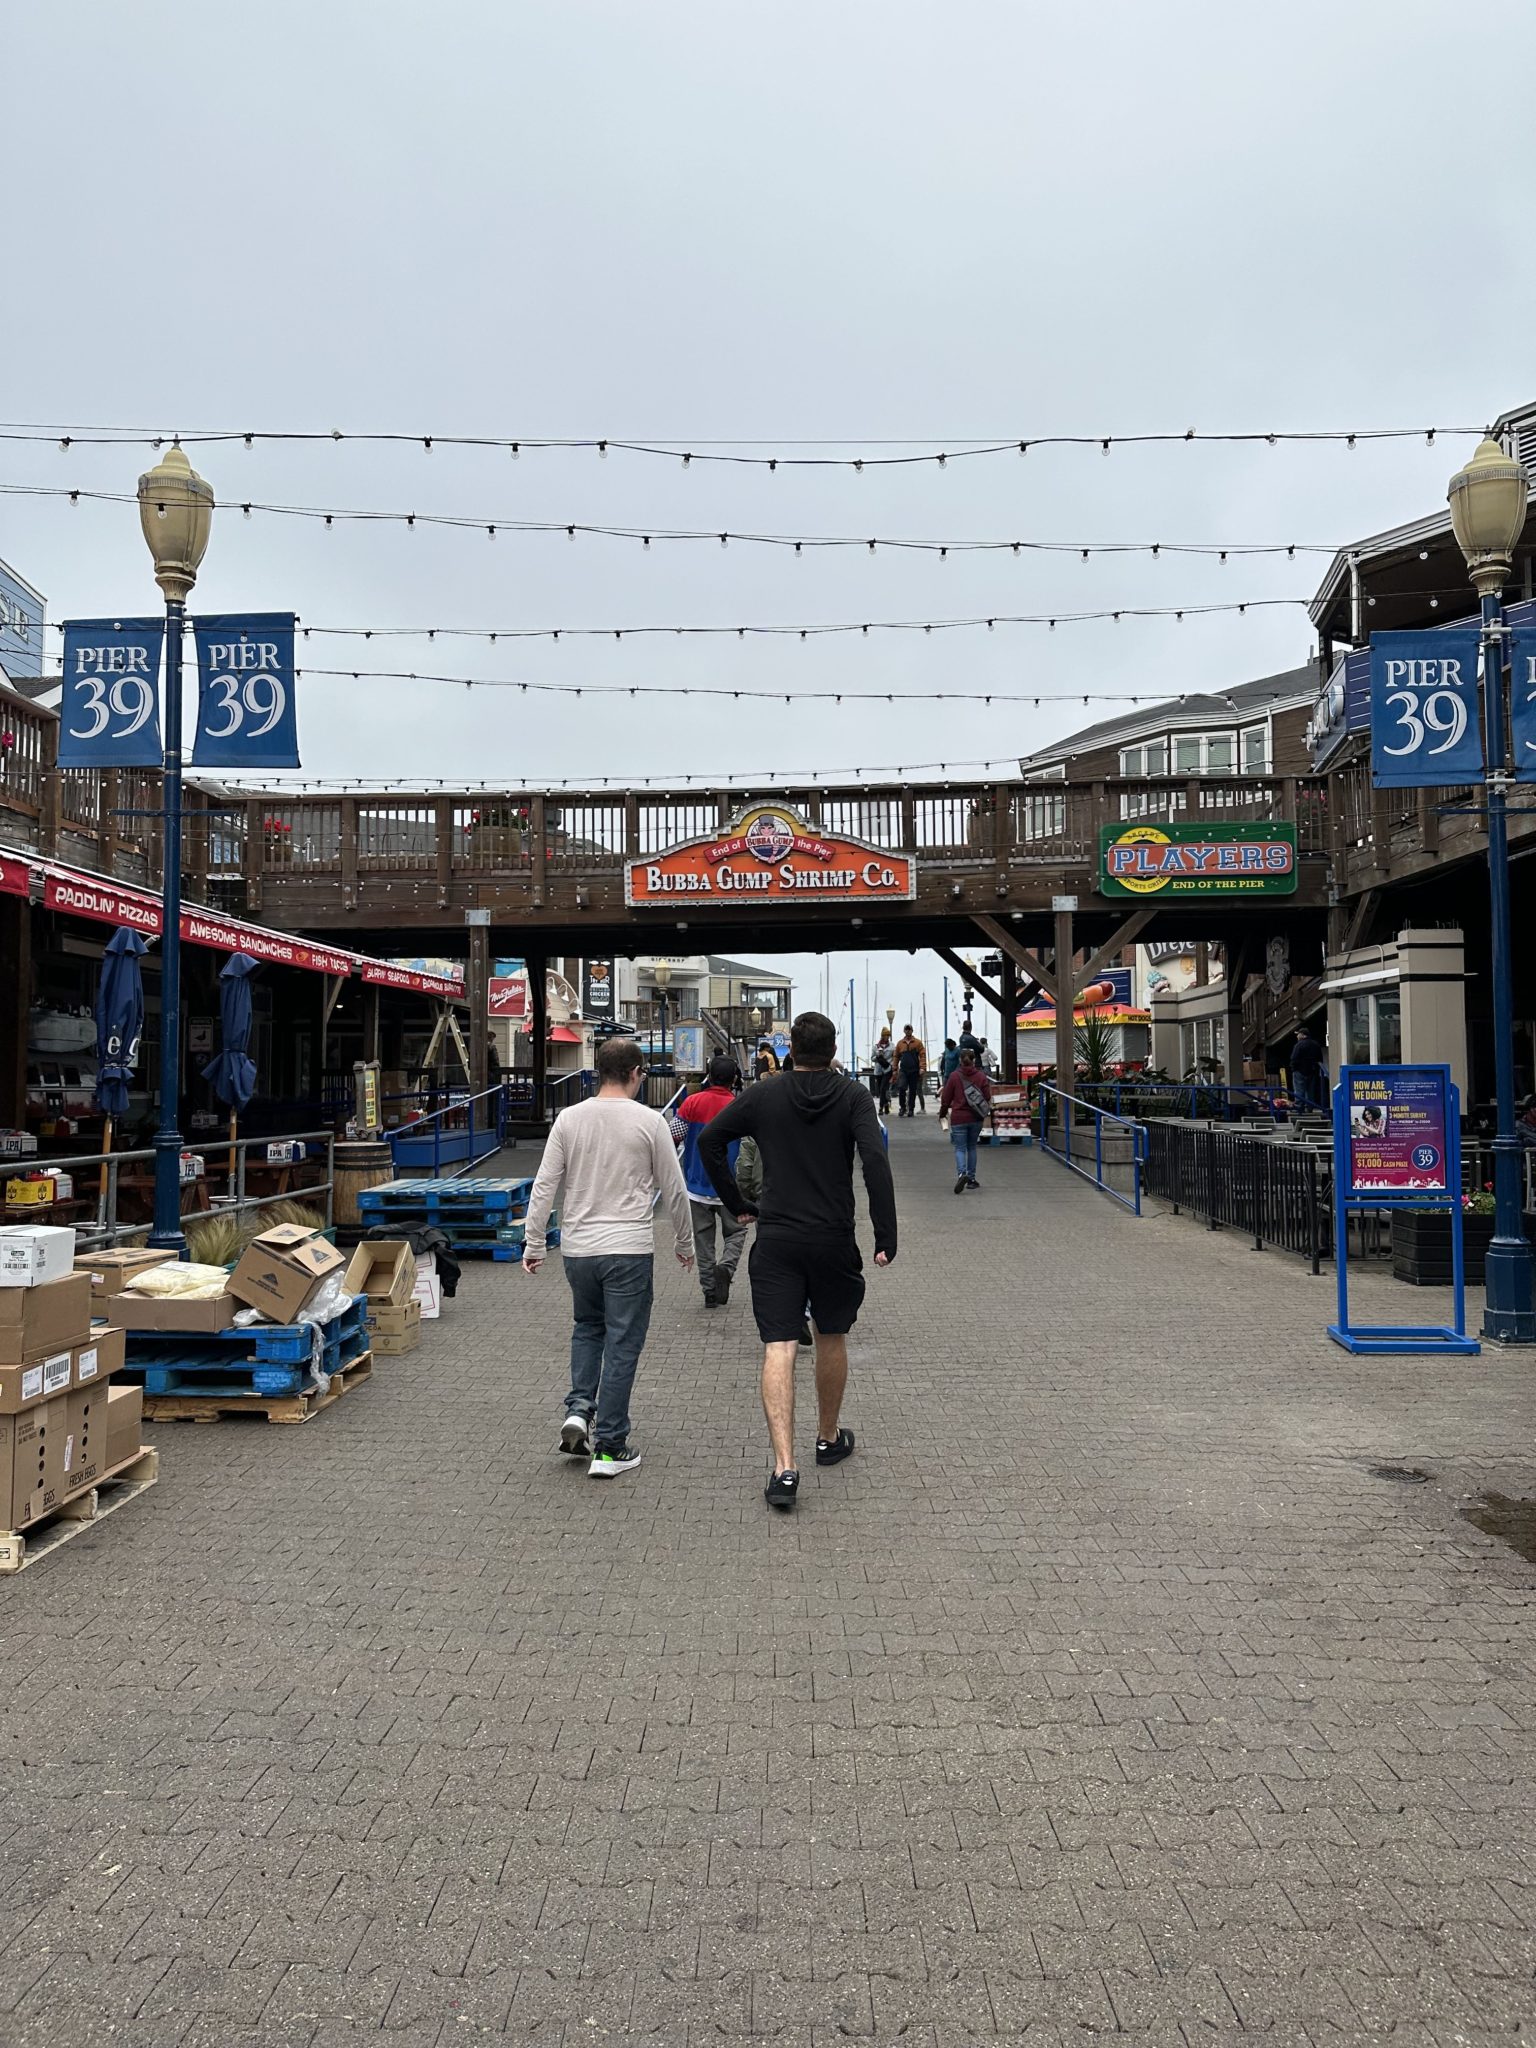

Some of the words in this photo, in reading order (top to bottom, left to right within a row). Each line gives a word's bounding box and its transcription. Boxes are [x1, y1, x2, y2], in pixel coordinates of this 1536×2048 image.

[76, 646, 151, 674] PIER
[208, 642, 281, 671] PIER
[1385, 659, 1464, 687] PIER
[69, 677, 153, 738] 39
[205, 674, 285, 737] 39
[1383, 691, 1467, 756] 39
[712, 844, 730, 857] End
[732, 840, 742, 850] of
[798, 840, 812, 850] the
[814, 845, 832, 857] Pier
[747, 837, 771, 847] BUBBA
[772, 836, 793, 847] GUMP
[1113, 846, 1288, 872] PLAYERS
[646, 866, 712, 892] BUBBA
[716, 865, 773, 890] GUMP
[779, 864, 856, 889] SHRIMP
[1172, 881, 1196, 889] END
[1198, 881, 1214, 889] OF
[1214, 880, 1237, 889] THE
[1238, 880, 1265, 888] PIER
[55, 887, 114, 914] PADDLIN'
[118, 903, 158, 928] PIZZAS
[190, 921, 237, 947] AWESOME
[239, 935, 292, 960] SANDWICHES
[311, 954, 327, 967] FISH
[387, 971, 410, 984] SEAFOOD
[1354, 1081, 1370, 1090] HOW
[1371, 1081, 1385, 1090] ARE
[1354, 1091, 1365, 1100] WE
[1365, 1090, 1392, 1100] DOING?
[6, 1141, 19, 1151] IPA
[185, 1163, 195, 1176] IPA
[1357, 1159, 1382, 1169] $1,000
[1418, 1155, 1434, 1166] 39
[69, 1469, 84, 1488] FRESH
[84, 1462, 97, 1480] EGGS
